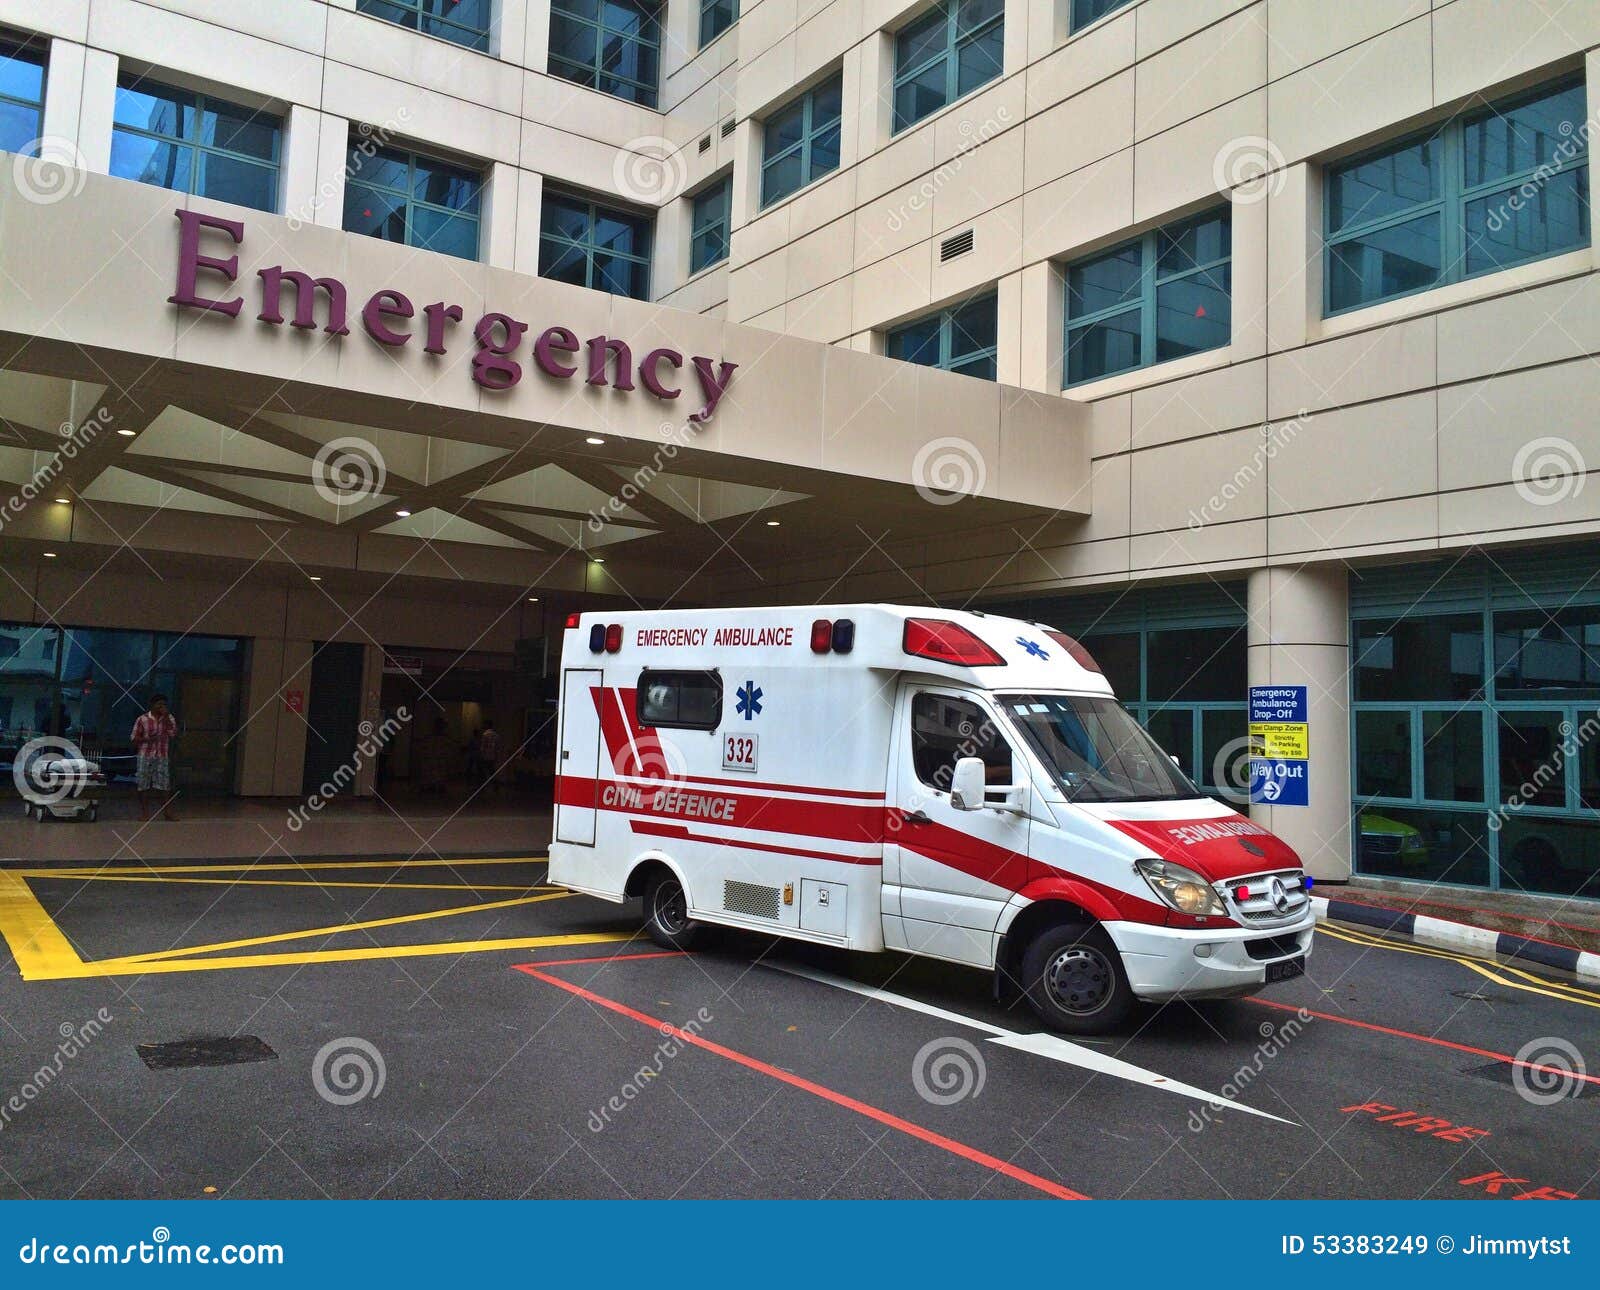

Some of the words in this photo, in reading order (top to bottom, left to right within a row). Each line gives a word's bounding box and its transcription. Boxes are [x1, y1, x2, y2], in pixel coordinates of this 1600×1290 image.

[168, 209, 739, 423] Emergency
[637, 628, 708, 646] EMERGENCY
[713, 627, 794, 646] AMBULANCE
[1252, 688, 1298, 699] Emergency
[1252, 699, 1298, 708] Ambulance
[1254, 709, 1293, 720] Drop-Off
[727, 737, 753, 763] 332
[1251, 763, 1273, 779] Way
[1275, 763, 1304, 778] Out
[602, 785, 645, 809] CIVIL
[652, 790, 738, 820] DEFENCE
[1340, 1102, 1493, 1143] FIRE
